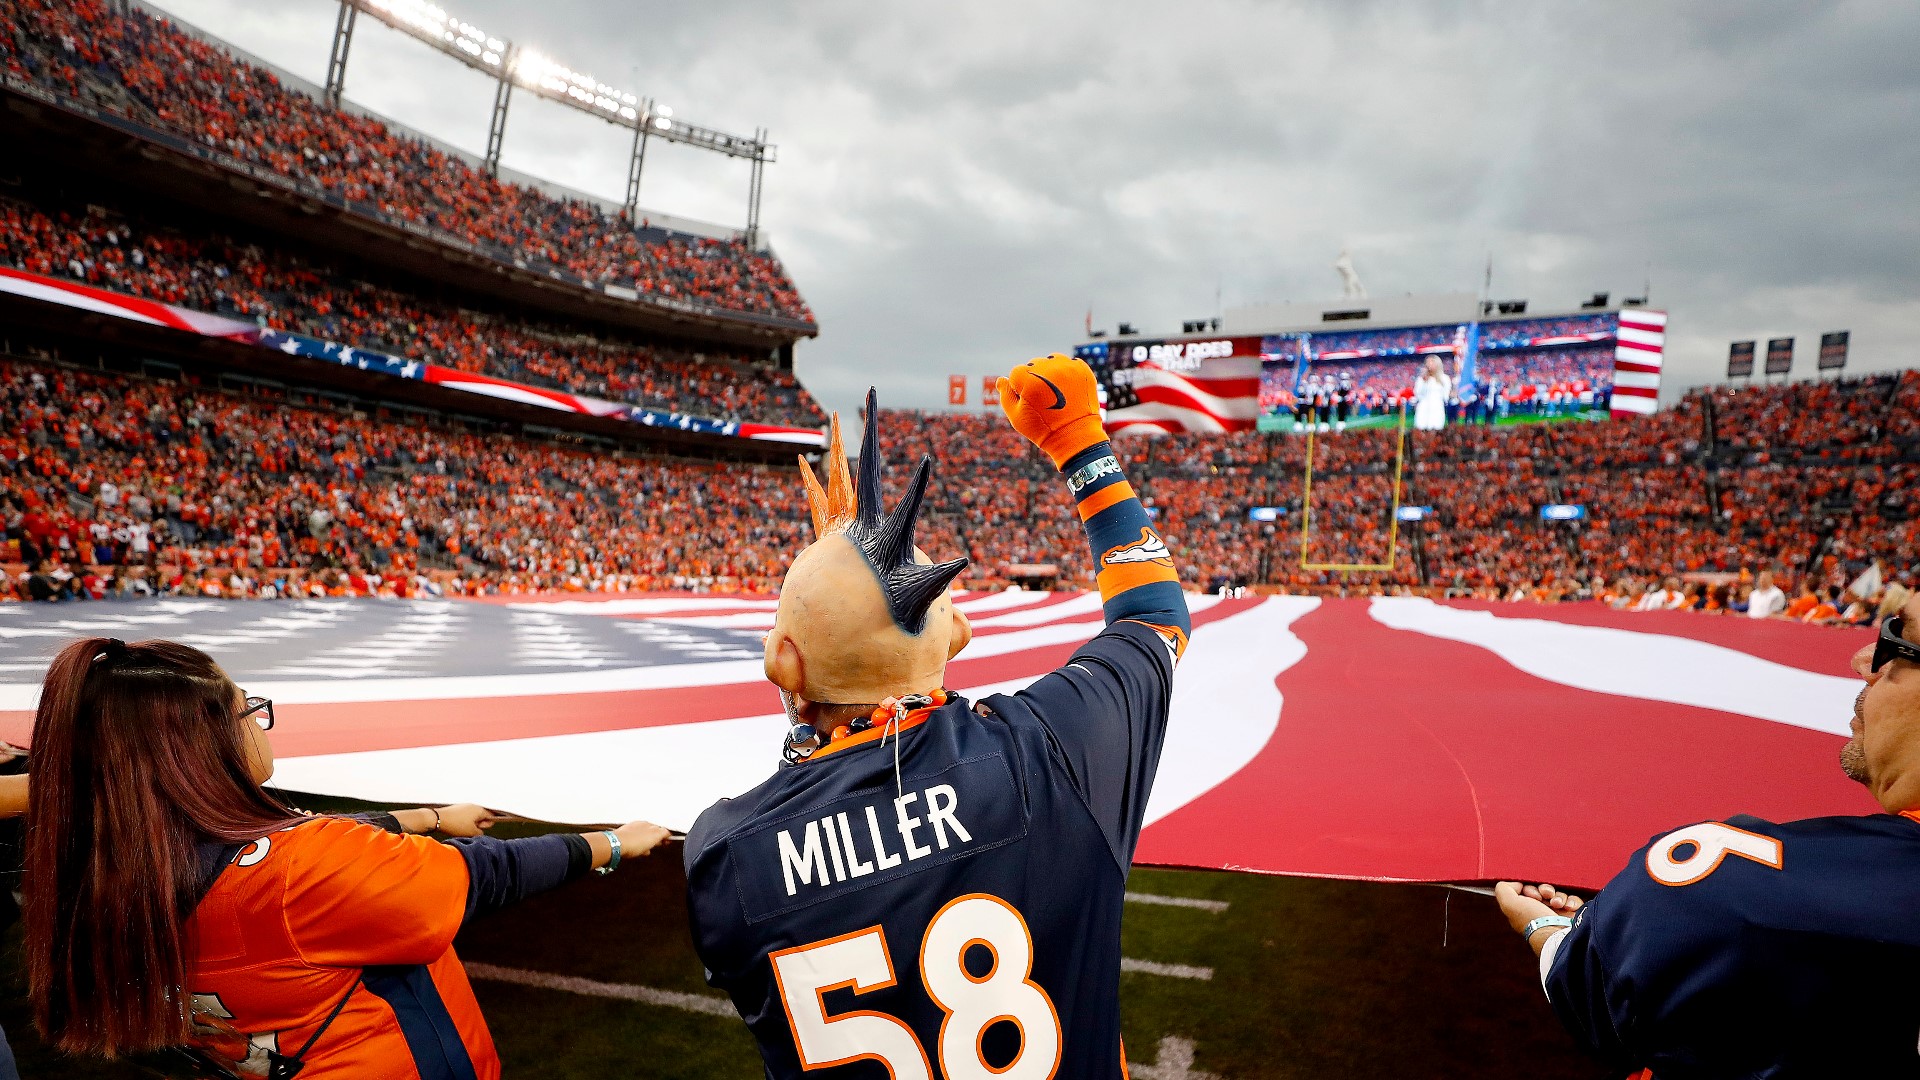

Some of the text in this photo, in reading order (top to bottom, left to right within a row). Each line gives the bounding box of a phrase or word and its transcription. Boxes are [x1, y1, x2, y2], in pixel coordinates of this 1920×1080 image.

[1133, 340, 1233, 362] O SAY DOES
[776, 783, 972, 896] MILLER
[768, 893, 1063, 1080] 58
